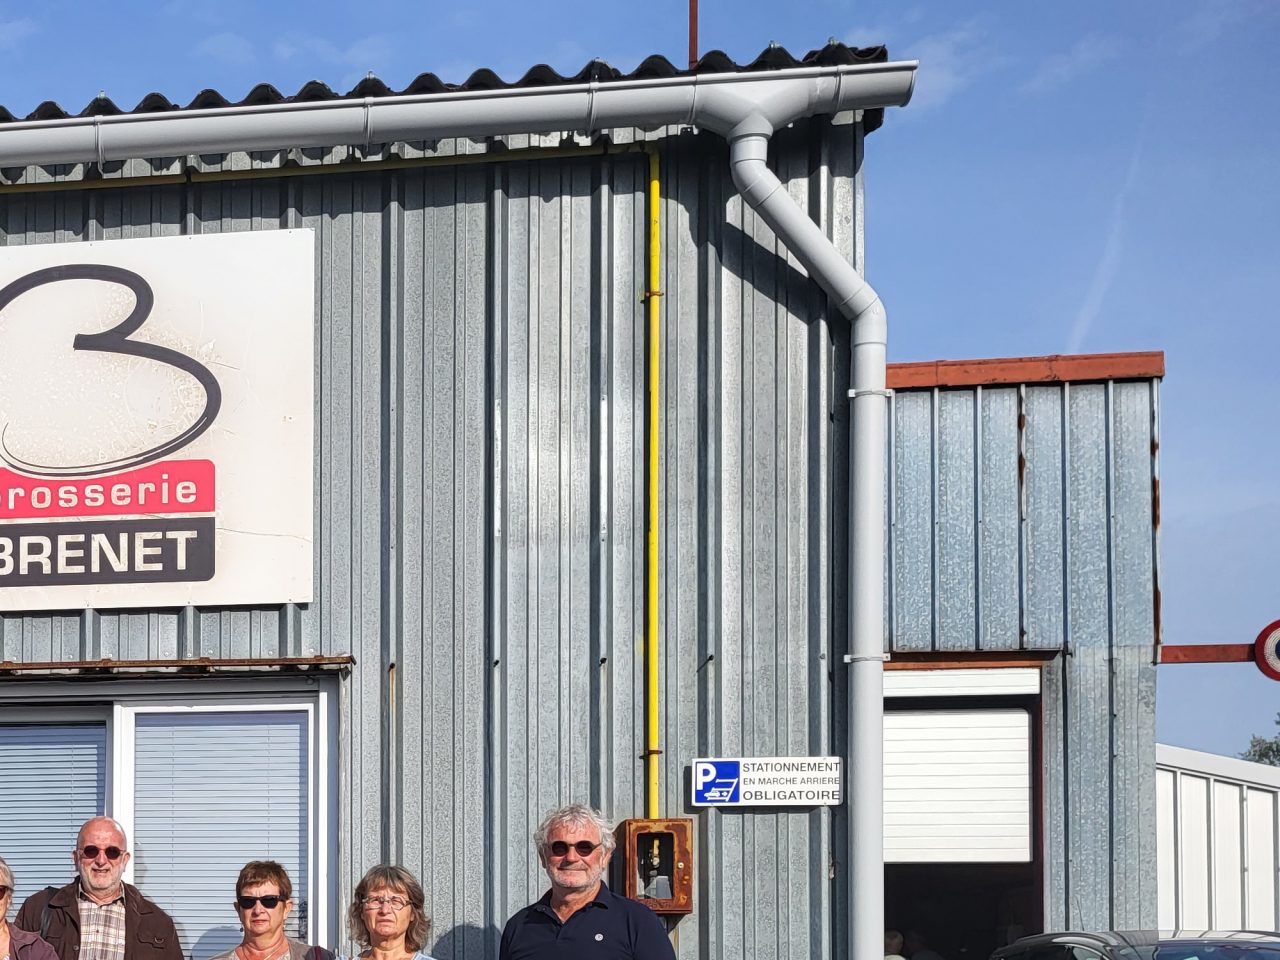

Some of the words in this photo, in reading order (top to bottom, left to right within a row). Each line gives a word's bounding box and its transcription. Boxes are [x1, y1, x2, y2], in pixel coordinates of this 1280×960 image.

[742, 762, 841, 772] STATIONNEMENT
[758, 777, 798, 785] MARCHE
[800, 777, 840, 785] ARRIERE
[742, 790, 841, 800] OBLIGATOIRE
